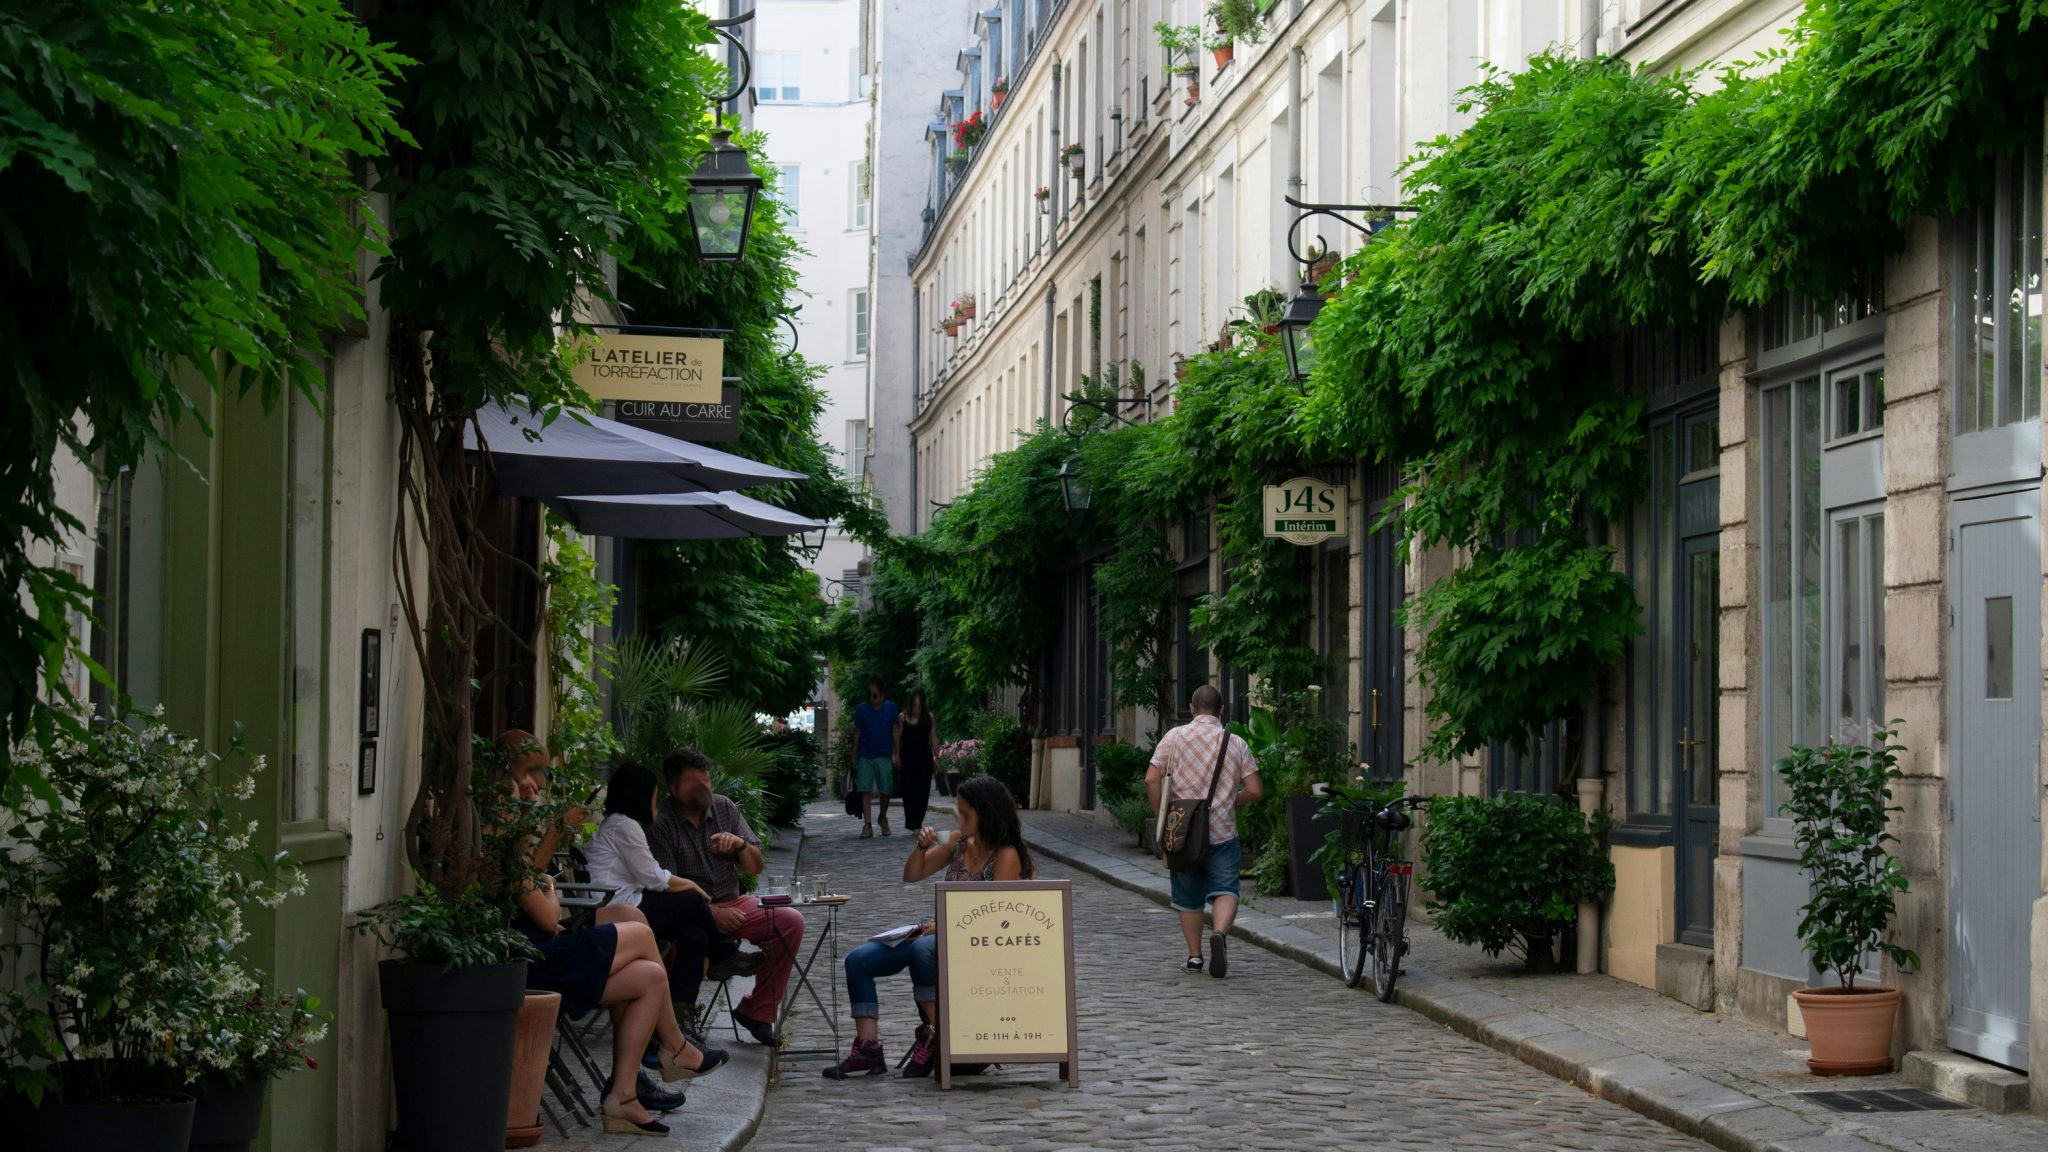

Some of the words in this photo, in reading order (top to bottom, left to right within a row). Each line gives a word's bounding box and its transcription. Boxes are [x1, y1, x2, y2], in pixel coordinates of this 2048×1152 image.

[591, 349, 687, 366] L'ATELIER
[691, 358, 702, 366] de
[591, 364, 703, 381] TORRÉFACTION
[621, 401, 655, 417] CUIR
[659, 403, 681, 417] AU
[685, 404, 732, 419] CARRE
[1275, 486, 1335, 513] J4S
[1284, 520, 1327, 532] Intérim
[955, 900, 1055, 930] TORRÉFACTION
[970, 936, 989, 947] DE
[995, 933, 1041, 947] CAFÉS
[990, 967, 1024, 977] VENTE
[1003, 977, 1010, 986] &
[970, 985, 1044, 995] DÉGUSTATION
[975, 1032, 989, 1041] DE
[993, 1032, 1009, 1040] 11H
[1013, 1030, 1020, 1040] À
[1024, 1031, 1042, 1040] 19H
